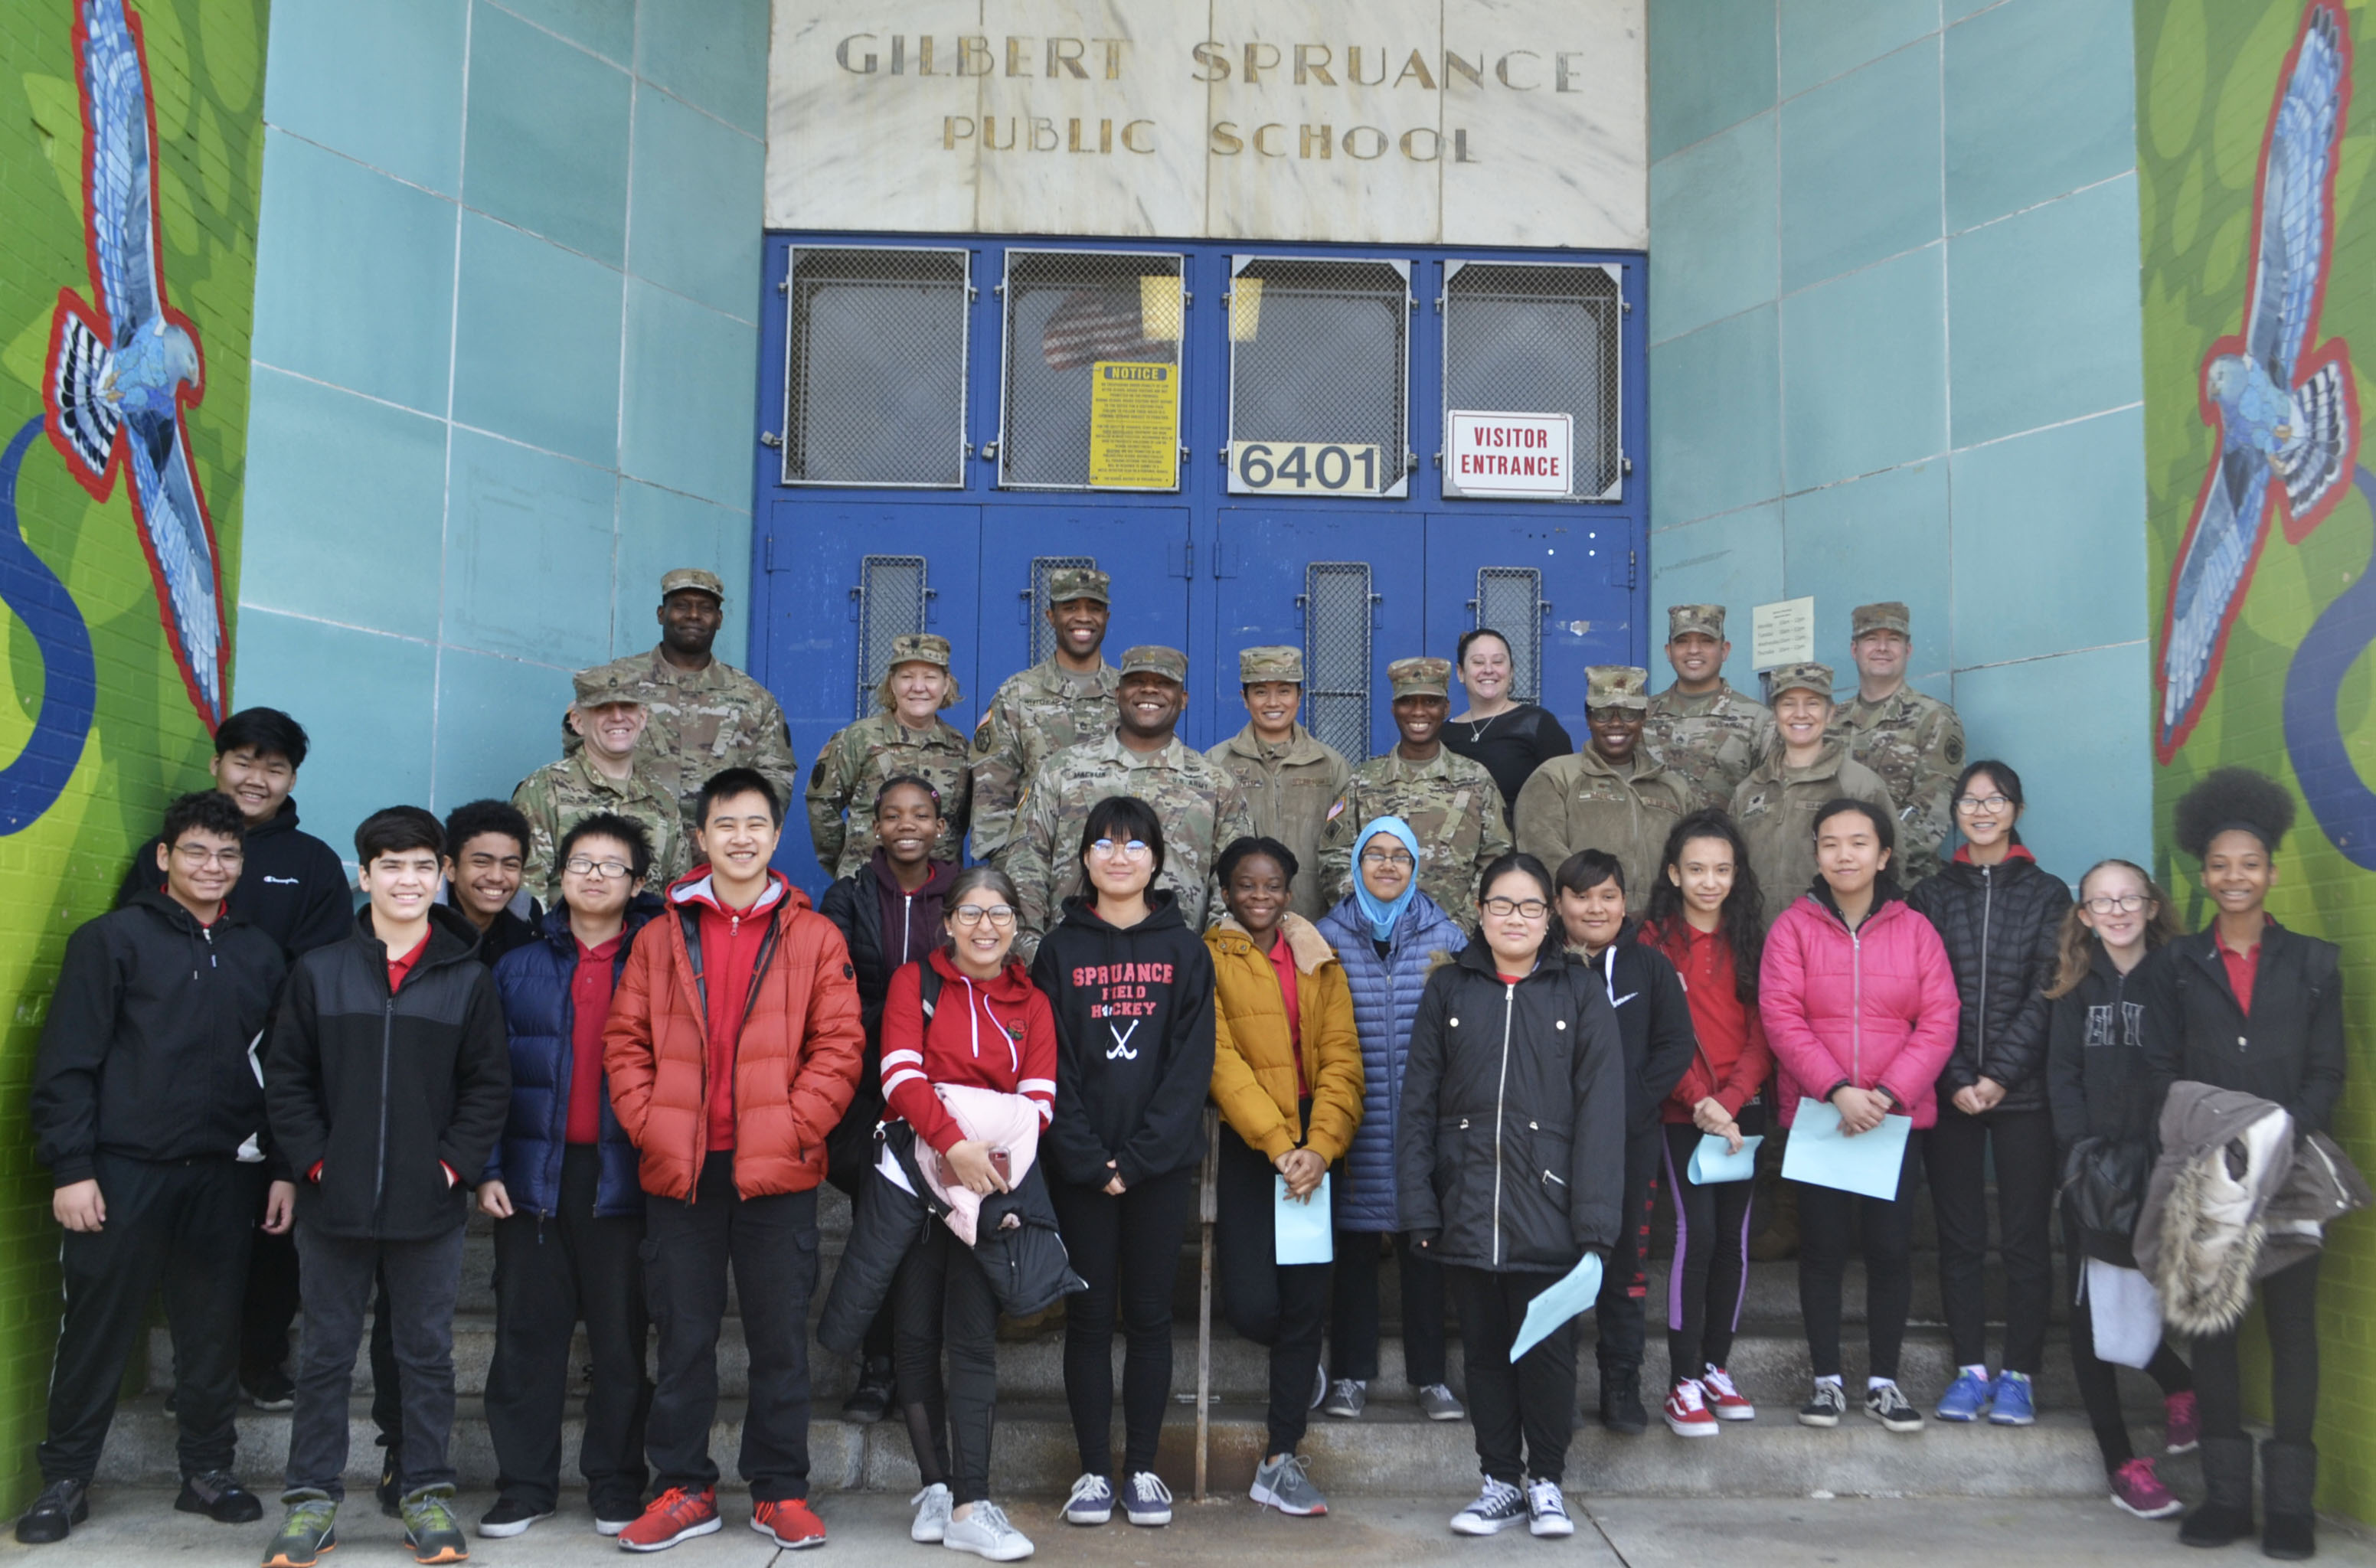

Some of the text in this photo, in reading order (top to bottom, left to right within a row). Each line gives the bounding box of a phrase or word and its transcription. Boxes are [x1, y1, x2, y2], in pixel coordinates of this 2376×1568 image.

[835, 33, 1583, 93] GILBERT SPRUANCE
[943, 115, 1480, 164] PUBLIC SCHOOL
[1112, 368, 1159, 380] NOTICE
[1474, 426, 1548, 449] VISITOR
[1239, 444, 1376, 489] 6401
[1461, 454, 1560, 477] ENTRANCE
[1072, 962, 1174, 987] SPRUANCE
